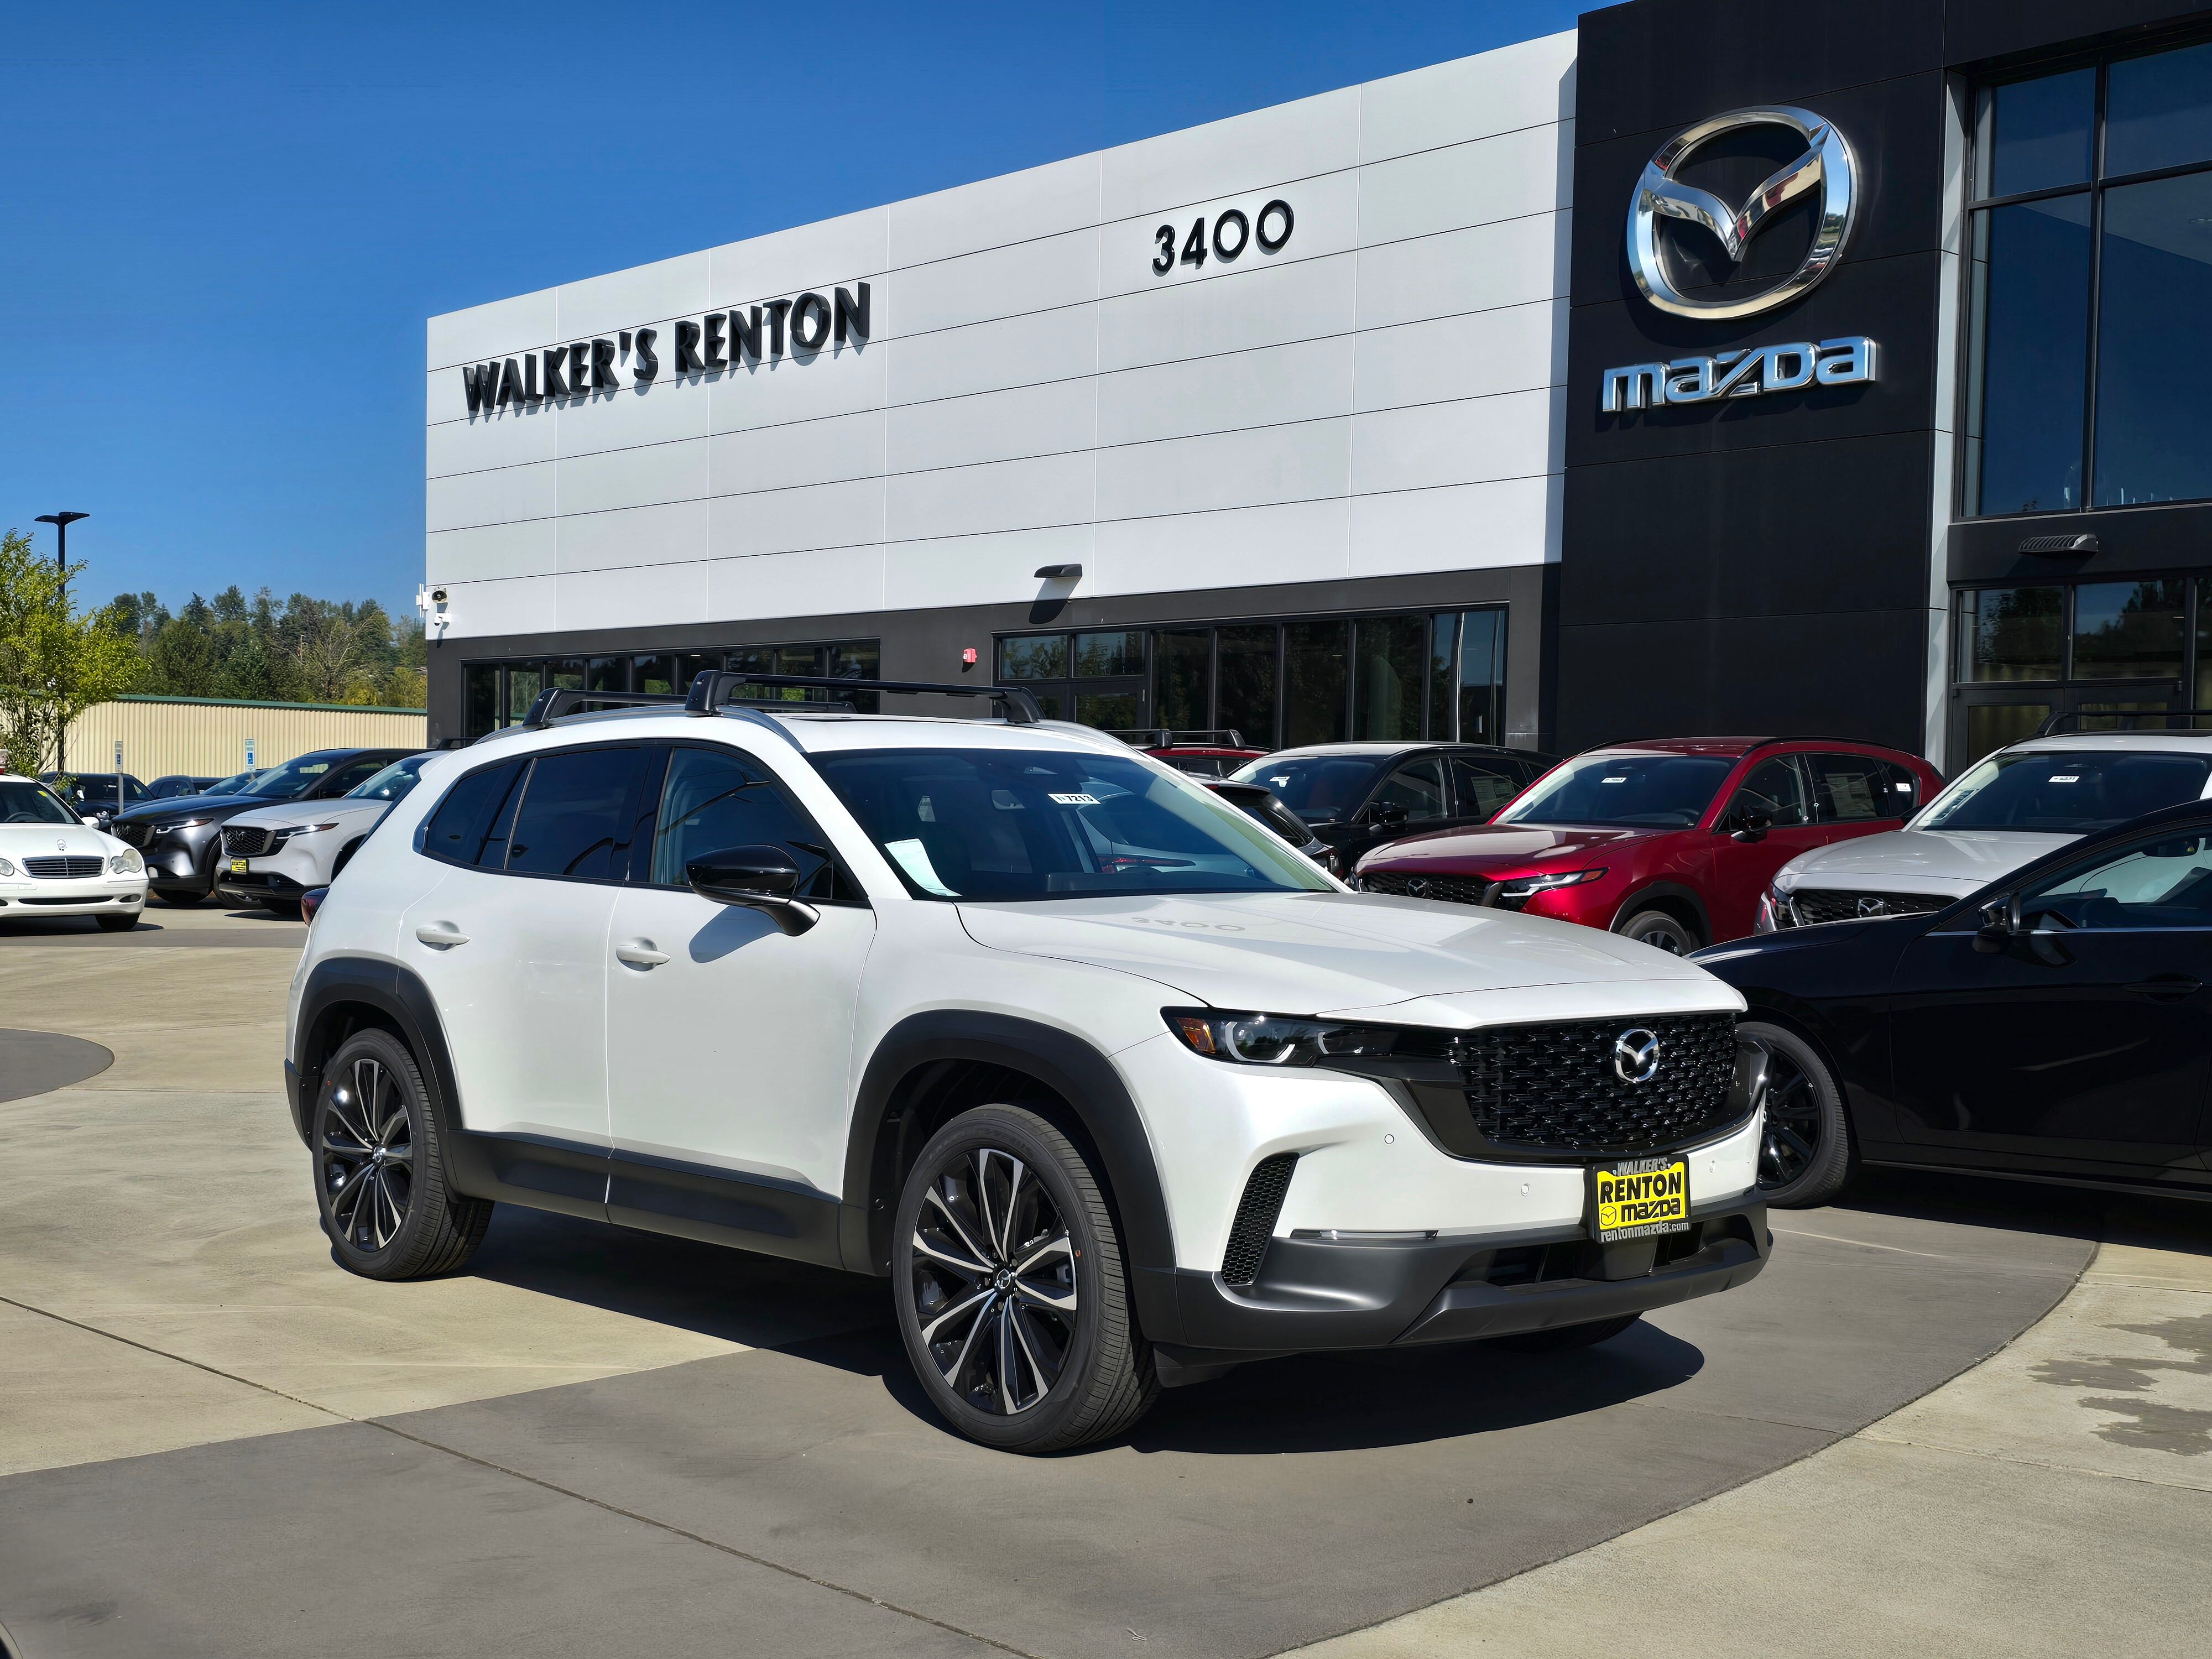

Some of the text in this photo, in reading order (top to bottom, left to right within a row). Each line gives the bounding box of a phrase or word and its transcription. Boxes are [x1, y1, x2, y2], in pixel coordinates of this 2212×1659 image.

[1152, 199, 1295, 272] 3400
[462, 281, 871, 412] WALKER'S RENTON
[1617, 1157, 1668, 1177] WALKER'S
[1599, 1171, 1682, 1204] RENTON
[1600, 1220, 1690, 1243] rentonmazda.com
